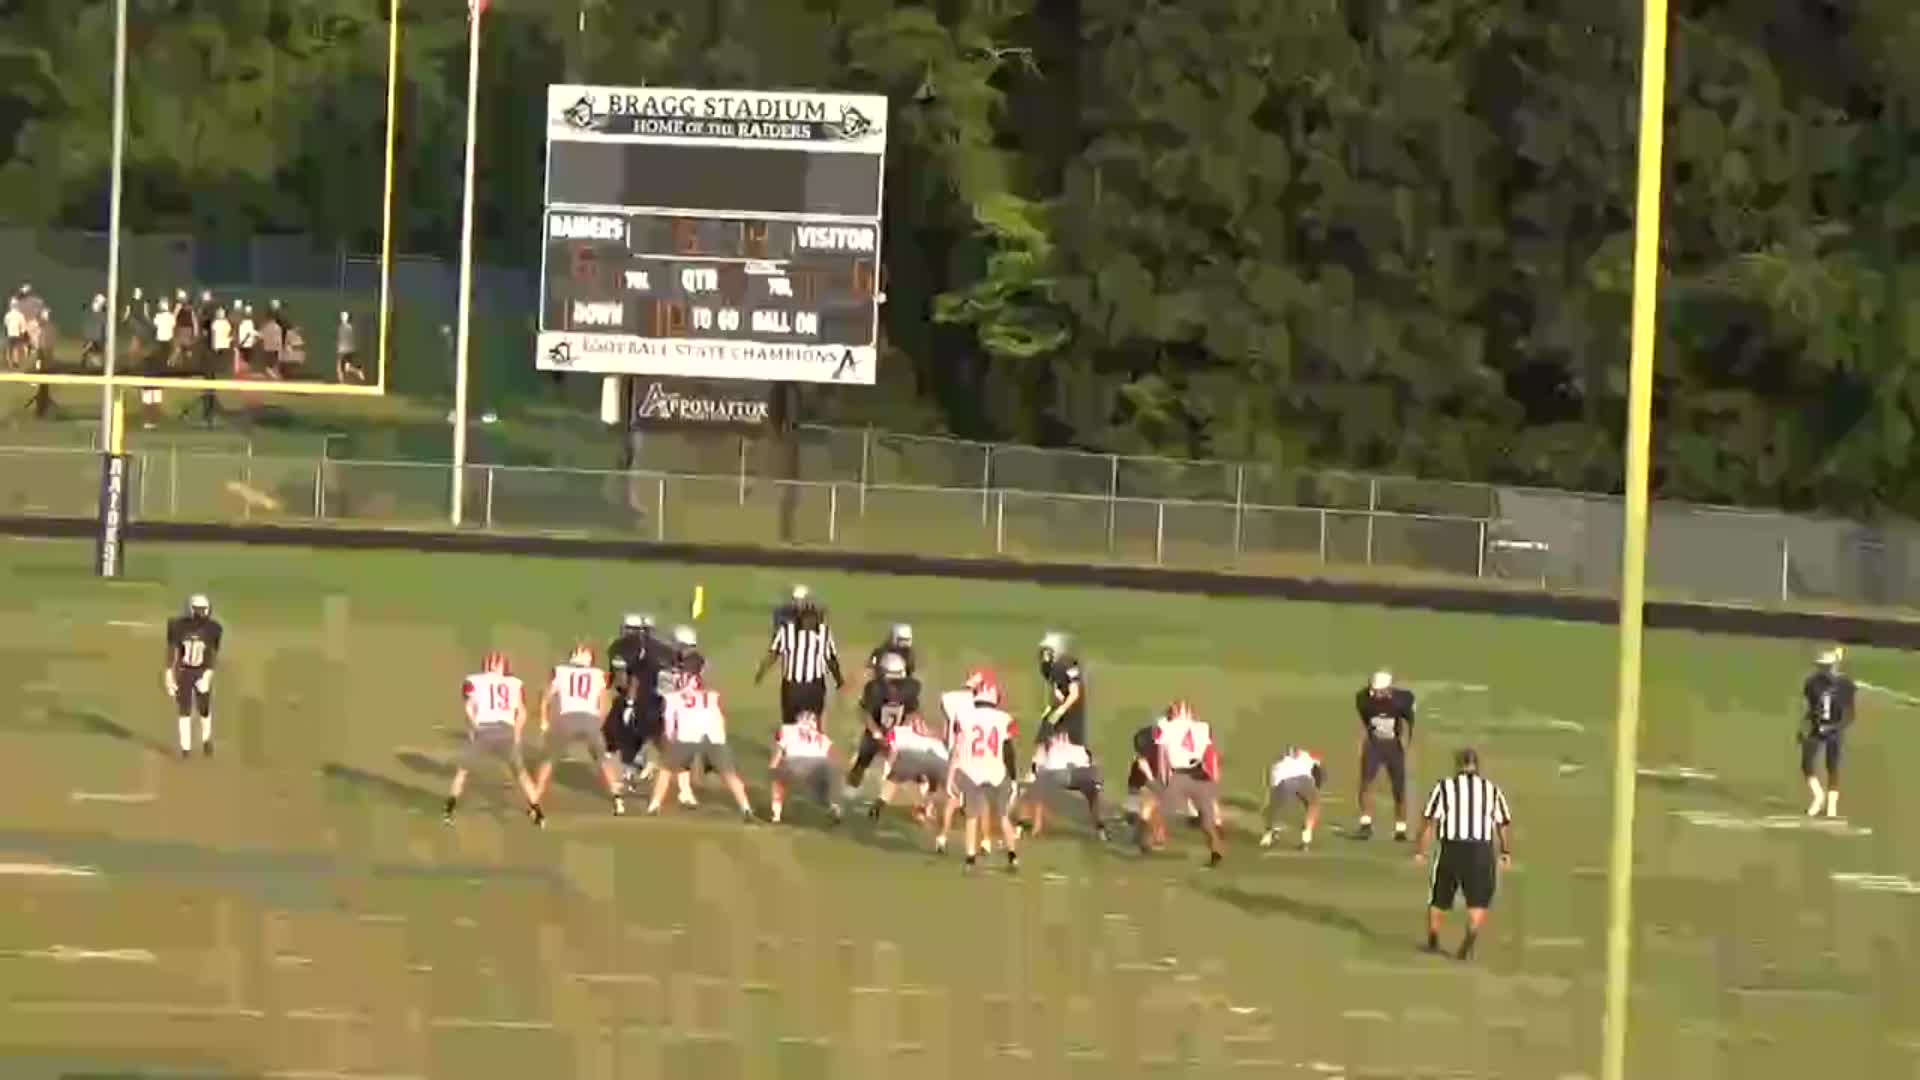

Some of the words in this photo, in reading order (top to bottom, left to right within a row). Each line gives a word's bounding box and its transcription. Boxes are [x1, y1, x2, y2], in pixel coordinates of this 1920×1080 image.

[608, 93, 696, 117] BRAGG
[703, 97, 827, 121] STADIUM
[633, 119, 682, 135] HOME
[686, 122, 704, 134] OF
[707, 122, 734, 136] THE
[738, 121, 811, 139] RAIDERS
[797, 225, 874, 251] VISITOR
[574, 301, 623, 326] DOWN
[692, 306, 712, 330] TO
[718, 308, 739, 331] GO
[752, 310, 791, 333] BALL
[795, 312, 817, 335] ON
[582, 337, 668, 357] FOOTBALL
[675, 343, 726, 360] STATE
[729, 345, 837, 364] CHAMPIONS
[489, 683, 510, 711] 19
[569, 671, 592, 700] 10
[971, 724, 999, 758] 24
[1181, 727, 1195, 750] 4
